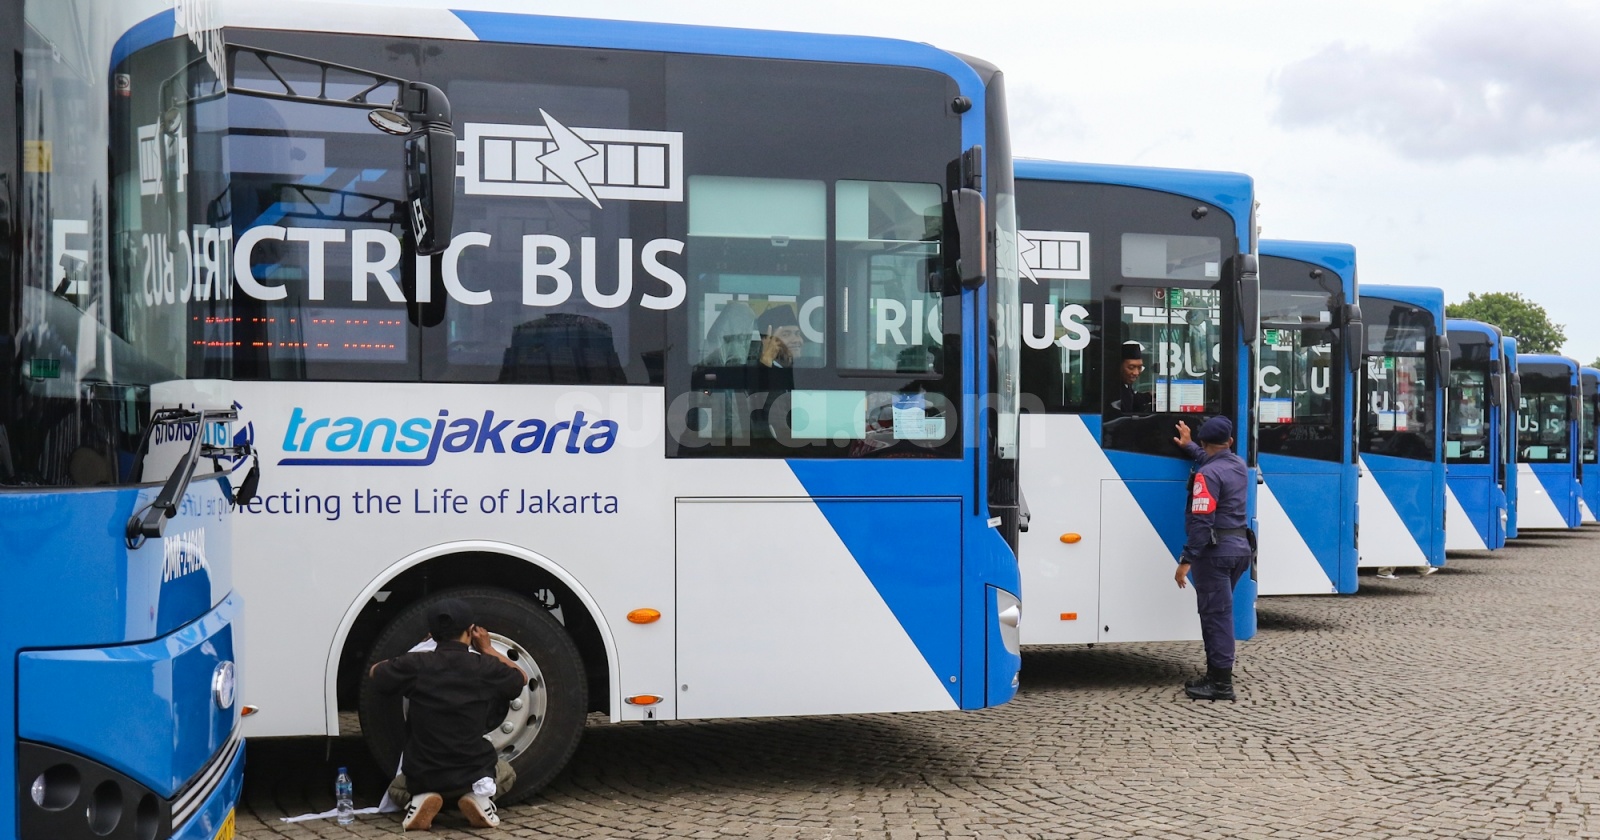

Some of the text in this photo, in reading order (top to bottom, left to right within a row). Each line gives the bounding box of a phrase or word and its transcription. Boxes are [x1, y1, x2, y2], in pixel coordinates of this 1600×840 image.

[521, 231, 687, 311] BUS
[277, 407, 620, 467] transjakarta
[352, 488, 402, 515] the
[414, 488, 469, 515] Life
[479, 488, 509, 515] of
[515, 488, 619, 515] Jakarta
